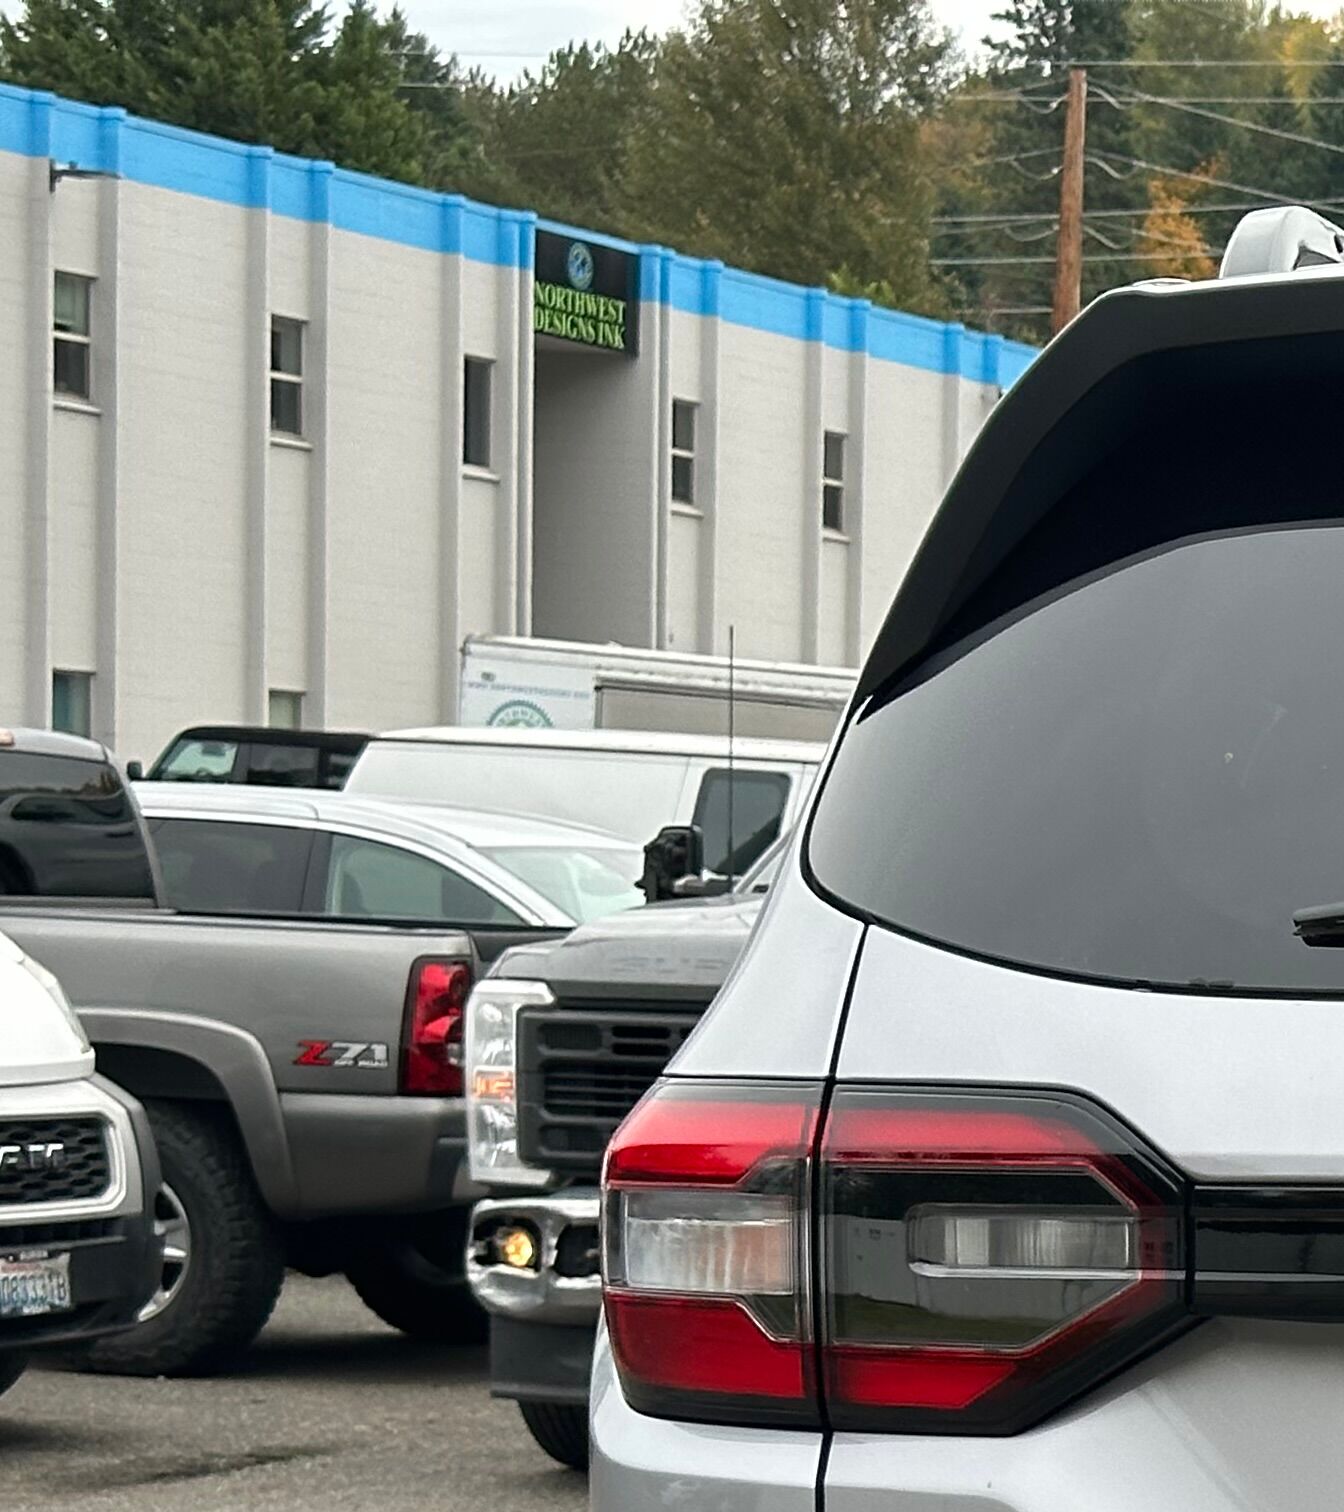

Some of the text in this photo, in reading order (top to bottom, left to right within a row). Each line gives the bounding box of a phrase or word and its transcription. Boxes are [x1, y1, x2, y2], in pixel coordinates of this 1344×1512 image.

[535, 280, 627, 324] NORTHWEST
[535, 306, 626, 349] DESIGNS INK
[294, 1040, 388, 1067] Z71
